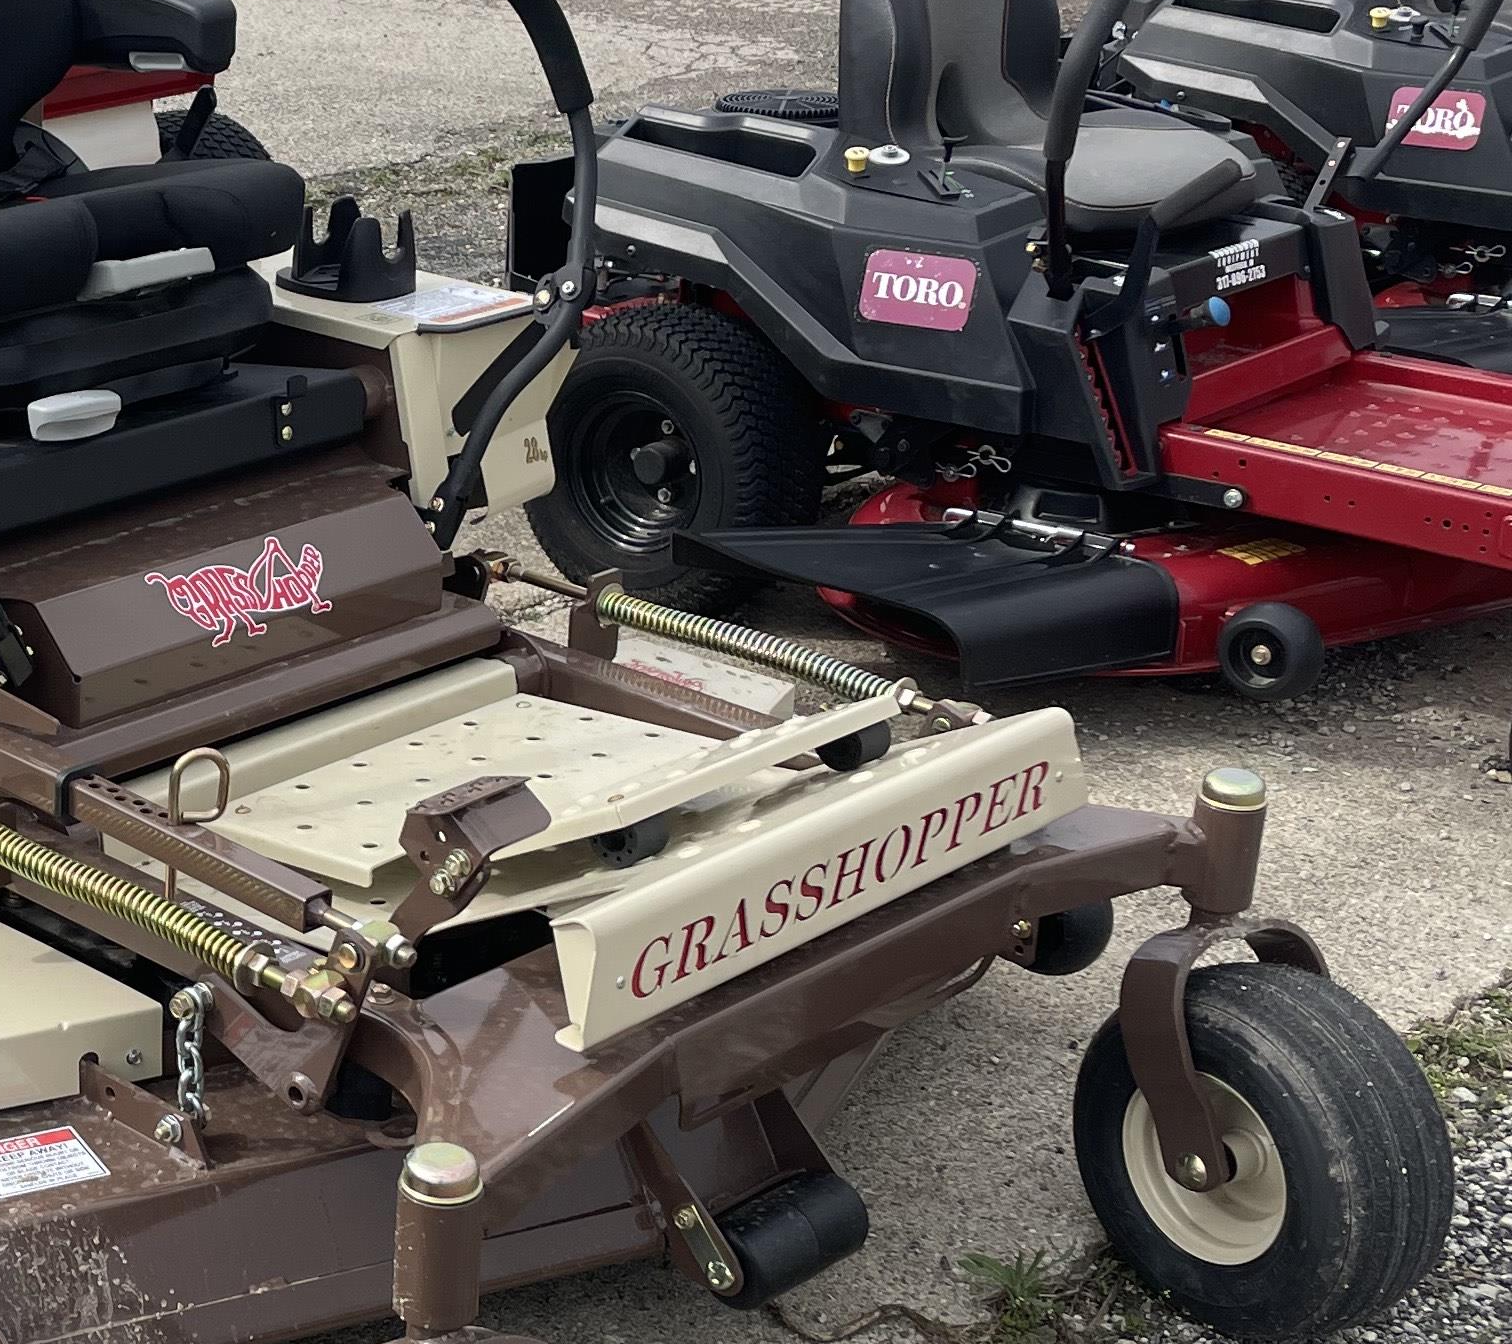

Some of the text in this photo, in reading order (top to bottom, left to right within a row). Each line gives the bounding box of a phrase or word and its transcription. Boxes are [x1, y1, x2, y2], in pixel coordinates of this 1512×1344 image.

[872, 271, 964, 308] TORO
[630, 760, 1050, 999] GRASSHOPPER
[29, 1143, 68, 1156] AWAY!
